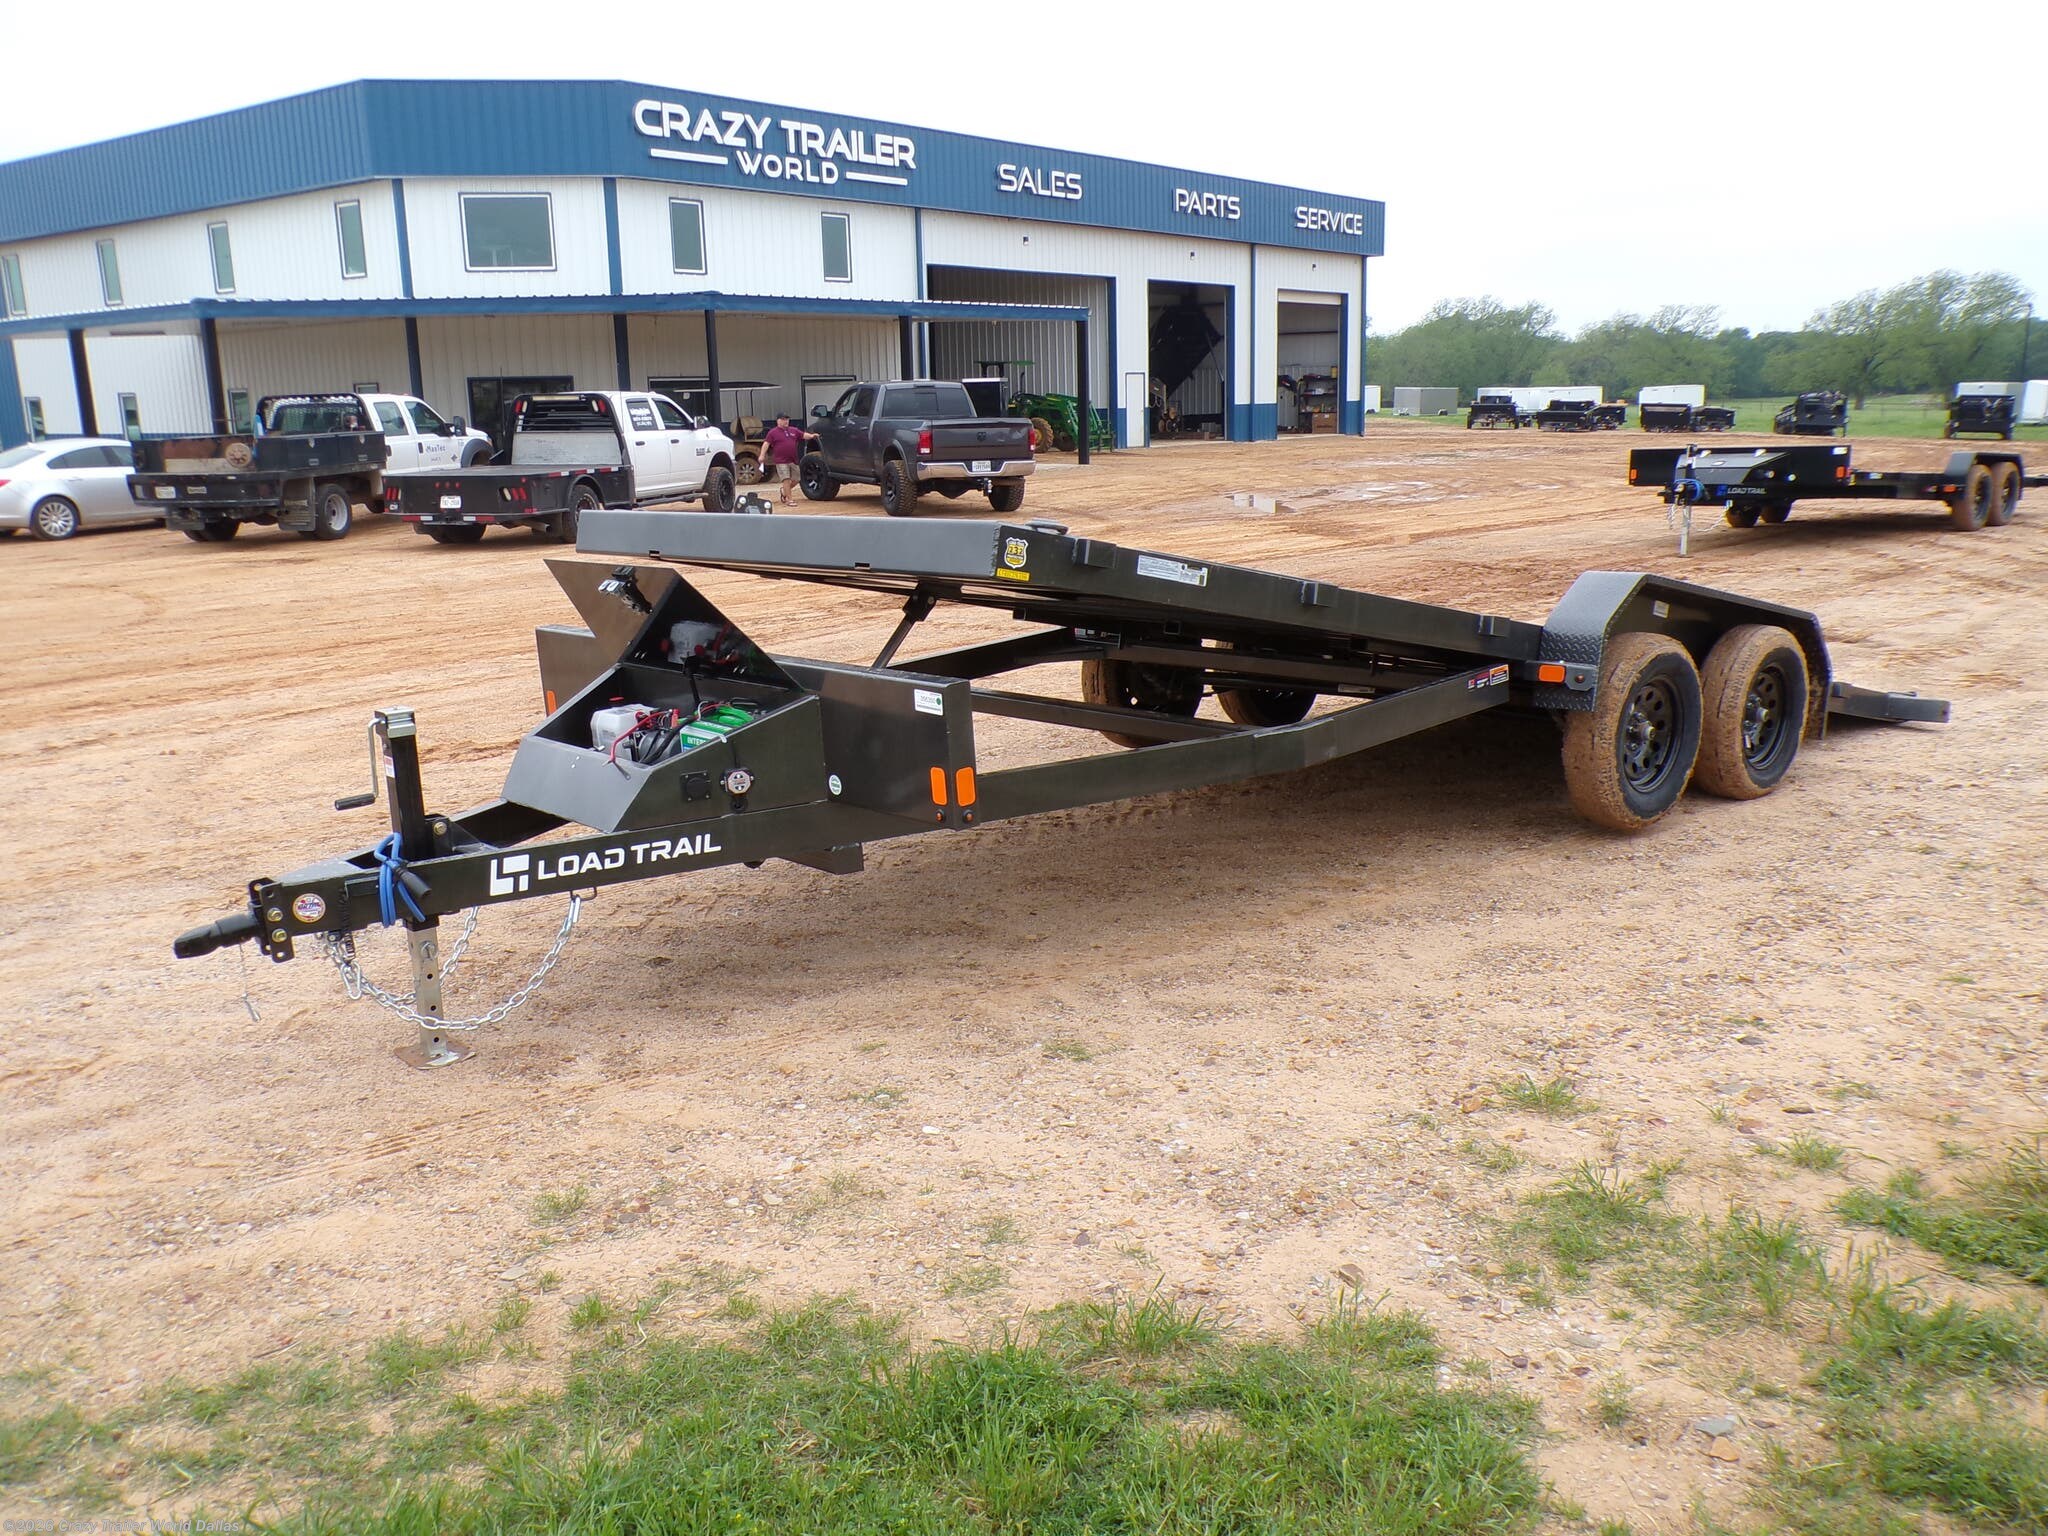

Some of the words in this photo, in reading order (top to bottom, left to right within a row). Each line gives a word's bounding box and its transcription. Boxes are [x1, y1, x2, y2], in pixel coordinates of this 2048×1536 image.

[633, 98, 772, 150] CRAZY
[780, 119, 917, 170] TRAILER
[736, 150, 839, 185] WORLD
[997, 163, 1083, 201] SALES
[1173, 187, 1241, 220] PARTS
[1294, 205, 1364, 236] SERVICE
[537, 846, 626, 881] LOAD
[630, 833, 722, 865] TRAIL
